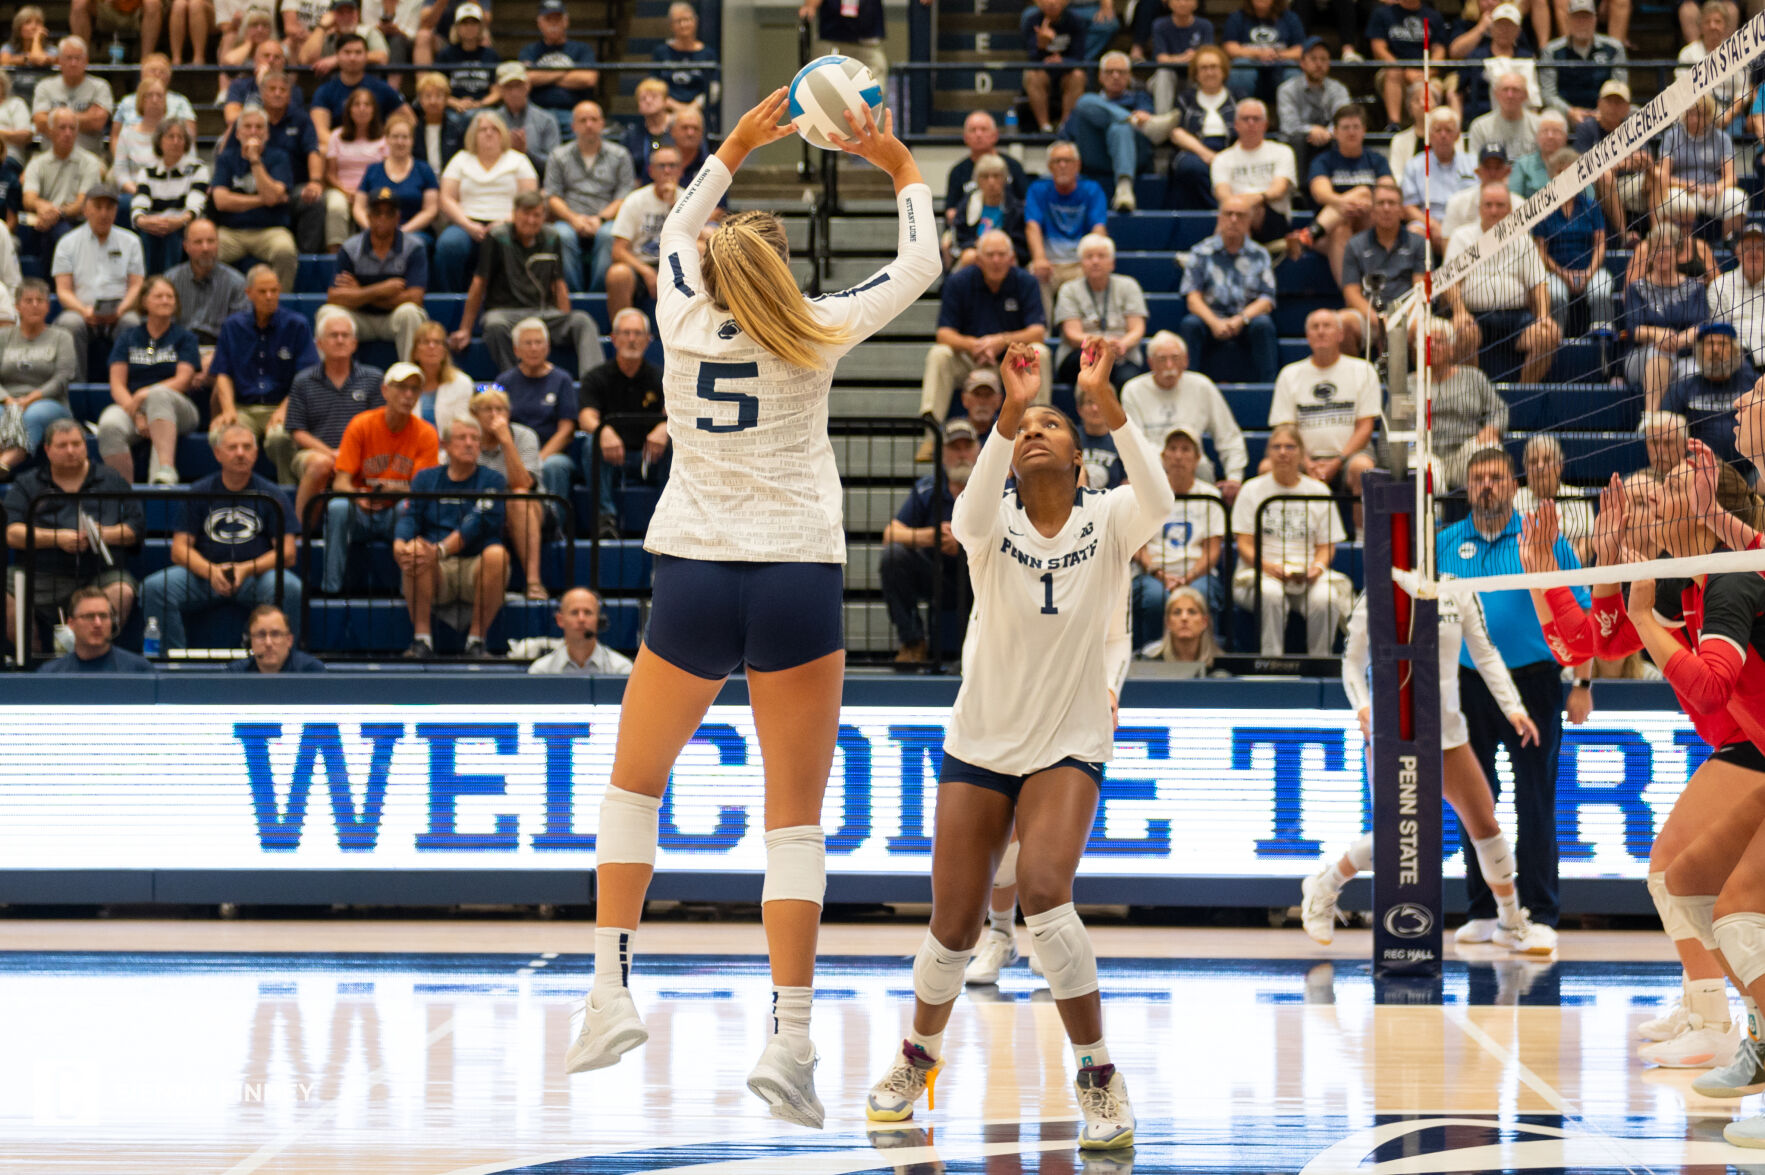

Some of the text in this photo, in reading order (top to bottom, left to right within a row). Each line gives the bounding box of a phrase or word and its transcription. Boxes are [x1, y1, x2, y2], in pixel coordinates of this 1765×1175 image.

[975, 32, 991, 55] E
[1692, 57, 1719, 94] PENN
[1719, 23, 1750, 73] STATE
[975, 71, 992, 95] D
[675, 168, 711, 214] NITTANY LIONS
[905, 197, 915, 223] NITTANY
[696, 361, 759, 433] 5
[1000, 537, 1098, 570] PENN STATE
[1040, 572, 1058, 614] 1
[1398, 755, 1418, 885] PENN STATE
[1384, 949, 1434, 961] REC HALL
